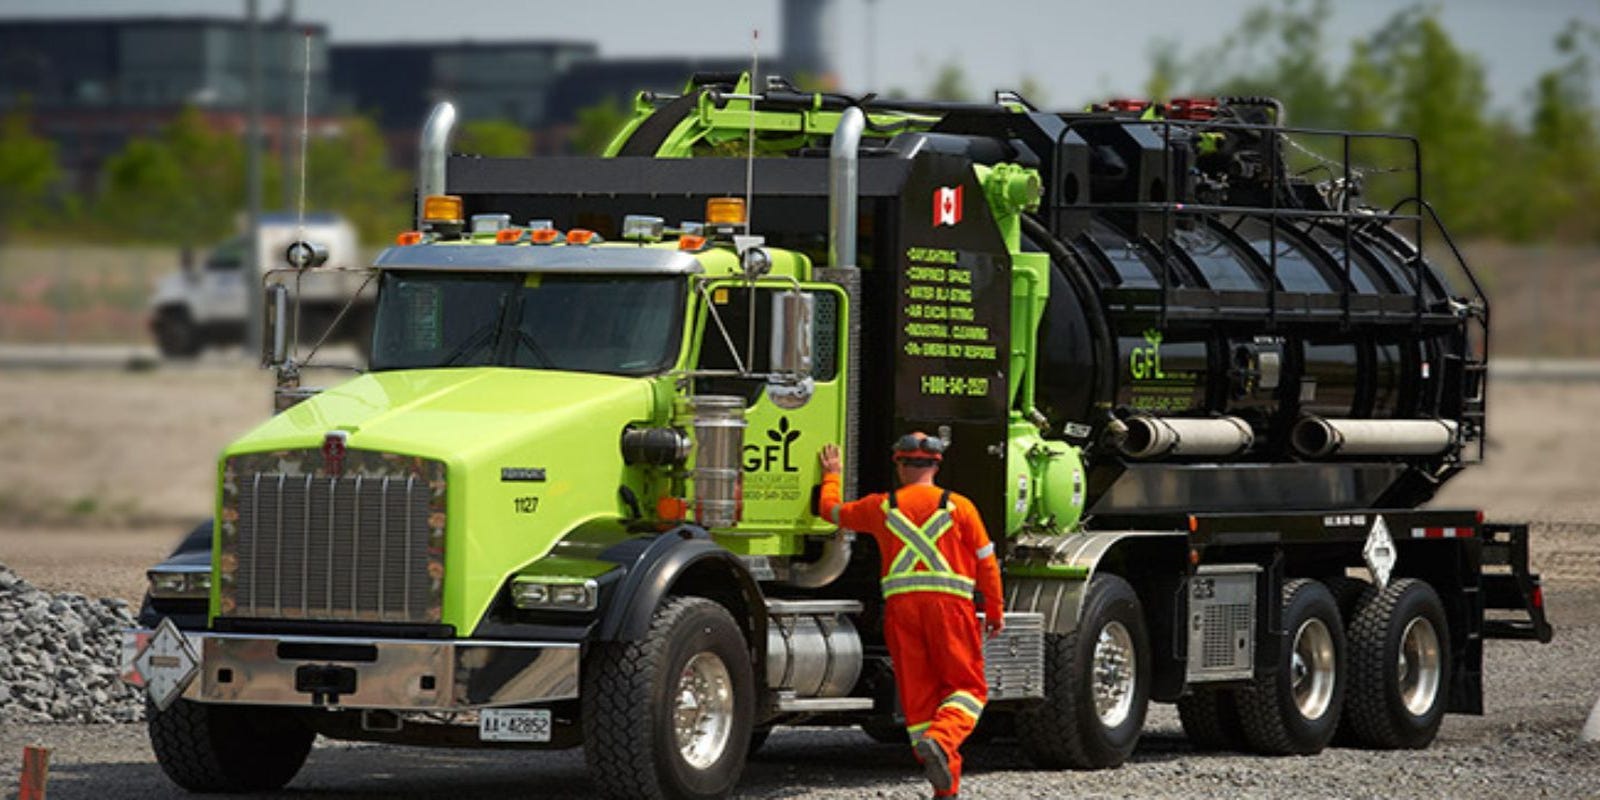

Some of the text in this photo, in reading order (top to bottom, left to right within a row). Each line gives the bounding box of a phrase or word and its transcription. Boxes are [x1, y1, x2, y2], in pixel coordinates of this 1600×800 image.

[1130, 339, 1165, 379] GFL
[742, 436, 799, 472] GFL
[514, 496, 539, 513] 1127
